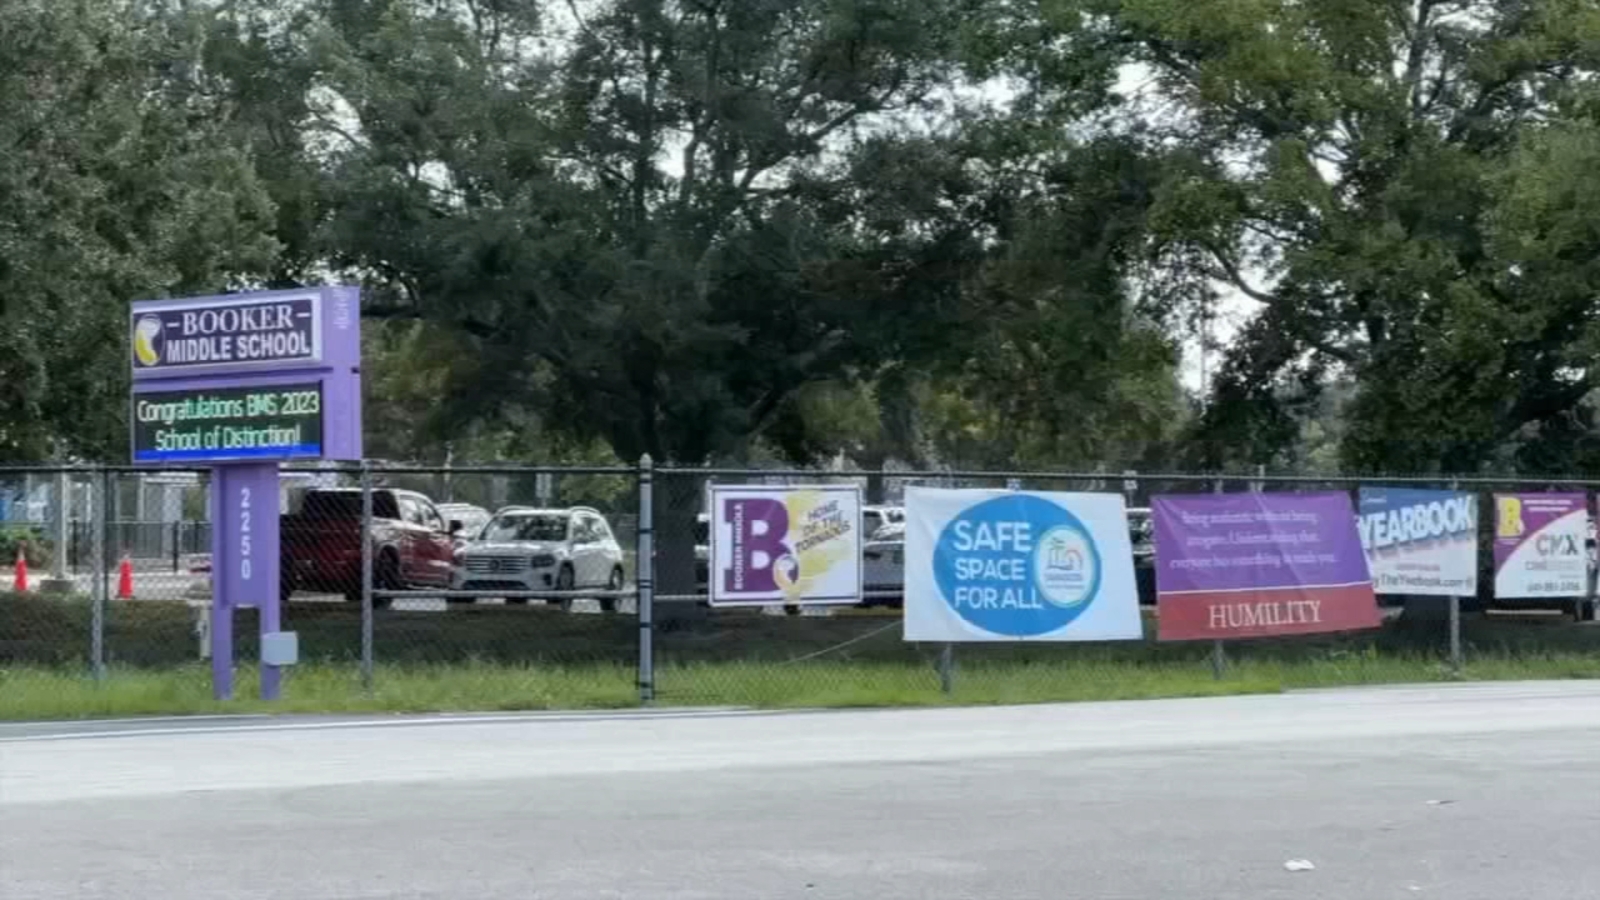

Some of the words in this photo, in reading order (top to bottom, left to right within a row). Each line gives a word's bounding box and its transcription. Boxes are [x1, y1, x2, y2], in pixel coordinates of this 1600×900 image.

[182, 305, 294, 335] BOOKER
[167, 335, 232, 363] MIDDLE
[236, 331, 310, 359] SCHOOL
[137, 395, 243, 424] Congratulations
[246, 394, 277, 416] BMS
[281, 391, 320, 415] 2023
[155, 428, 201, 451] School
[204, 425, 221, 450] of
[953, 519, 1032, 552] SAFE
[1357, 494, 1472, 549] YEARBOOK
[1536, 534, 1579, 556] CMX
[954, 558, 1026, 581] SPACE
[954, 587, 998, 609] FOR
[1001, 587, 1044, 610] ALL
[1208, 600, 1322, 629] HUMILITY
